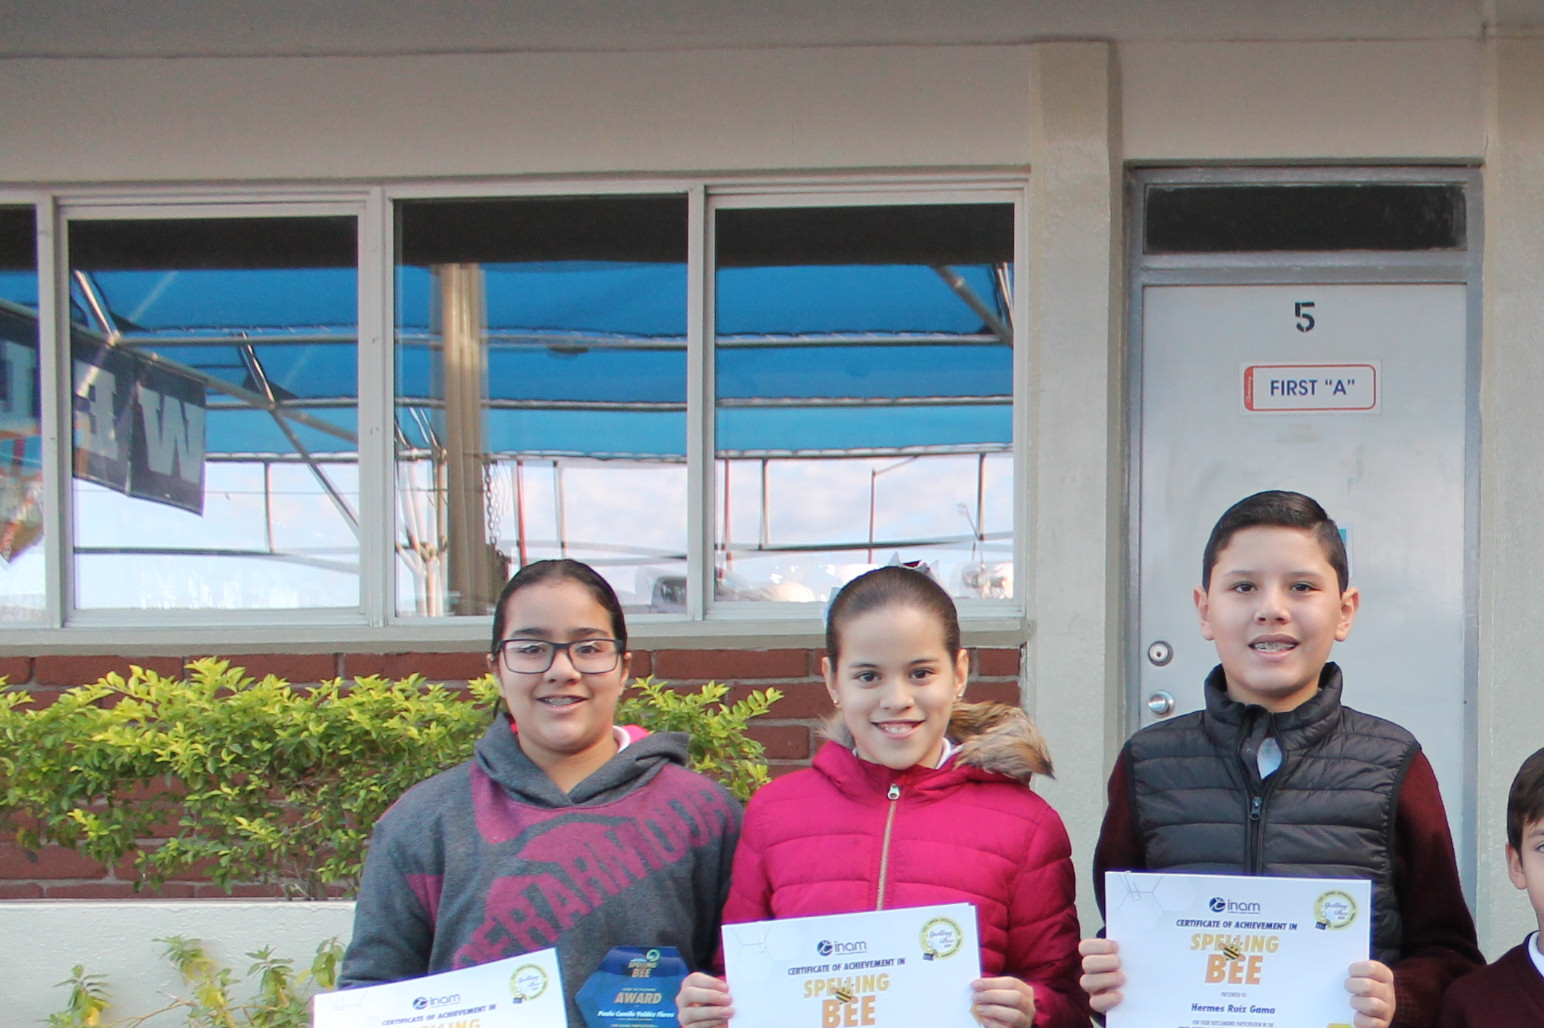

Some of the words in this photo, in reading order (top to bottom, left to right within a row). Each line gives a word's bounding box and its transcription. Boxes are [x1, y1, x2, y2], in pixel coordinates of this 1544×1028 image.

[1295, 302, 1315, 332] 5
[1270, 380, 1317, 396] FIRST
[1228, 899, 1260, 911] inam
[1235, 922, 1287, 930] ACHIEVEMENT
[834, 941, 867, 952] inam
[632, 969, 651, 977] BEE
[788, 965, 829, 975] CERTIFICATE
[844, 959, 895, 970] ACHIEVEMENT
[1205, 954, 1264, 984] BEE
[614, 992, 662, 1004] AWARD
[382, 1016, 423, 1025] CERTIFICATE
[438, 1006, 486, 1018] ACHIEVEMENT
[822, 995, 875, 1028] BEE
[1191, 1003, 1224, 1012] Hermes
[1250, 1005, 1275, 1014] Gama
